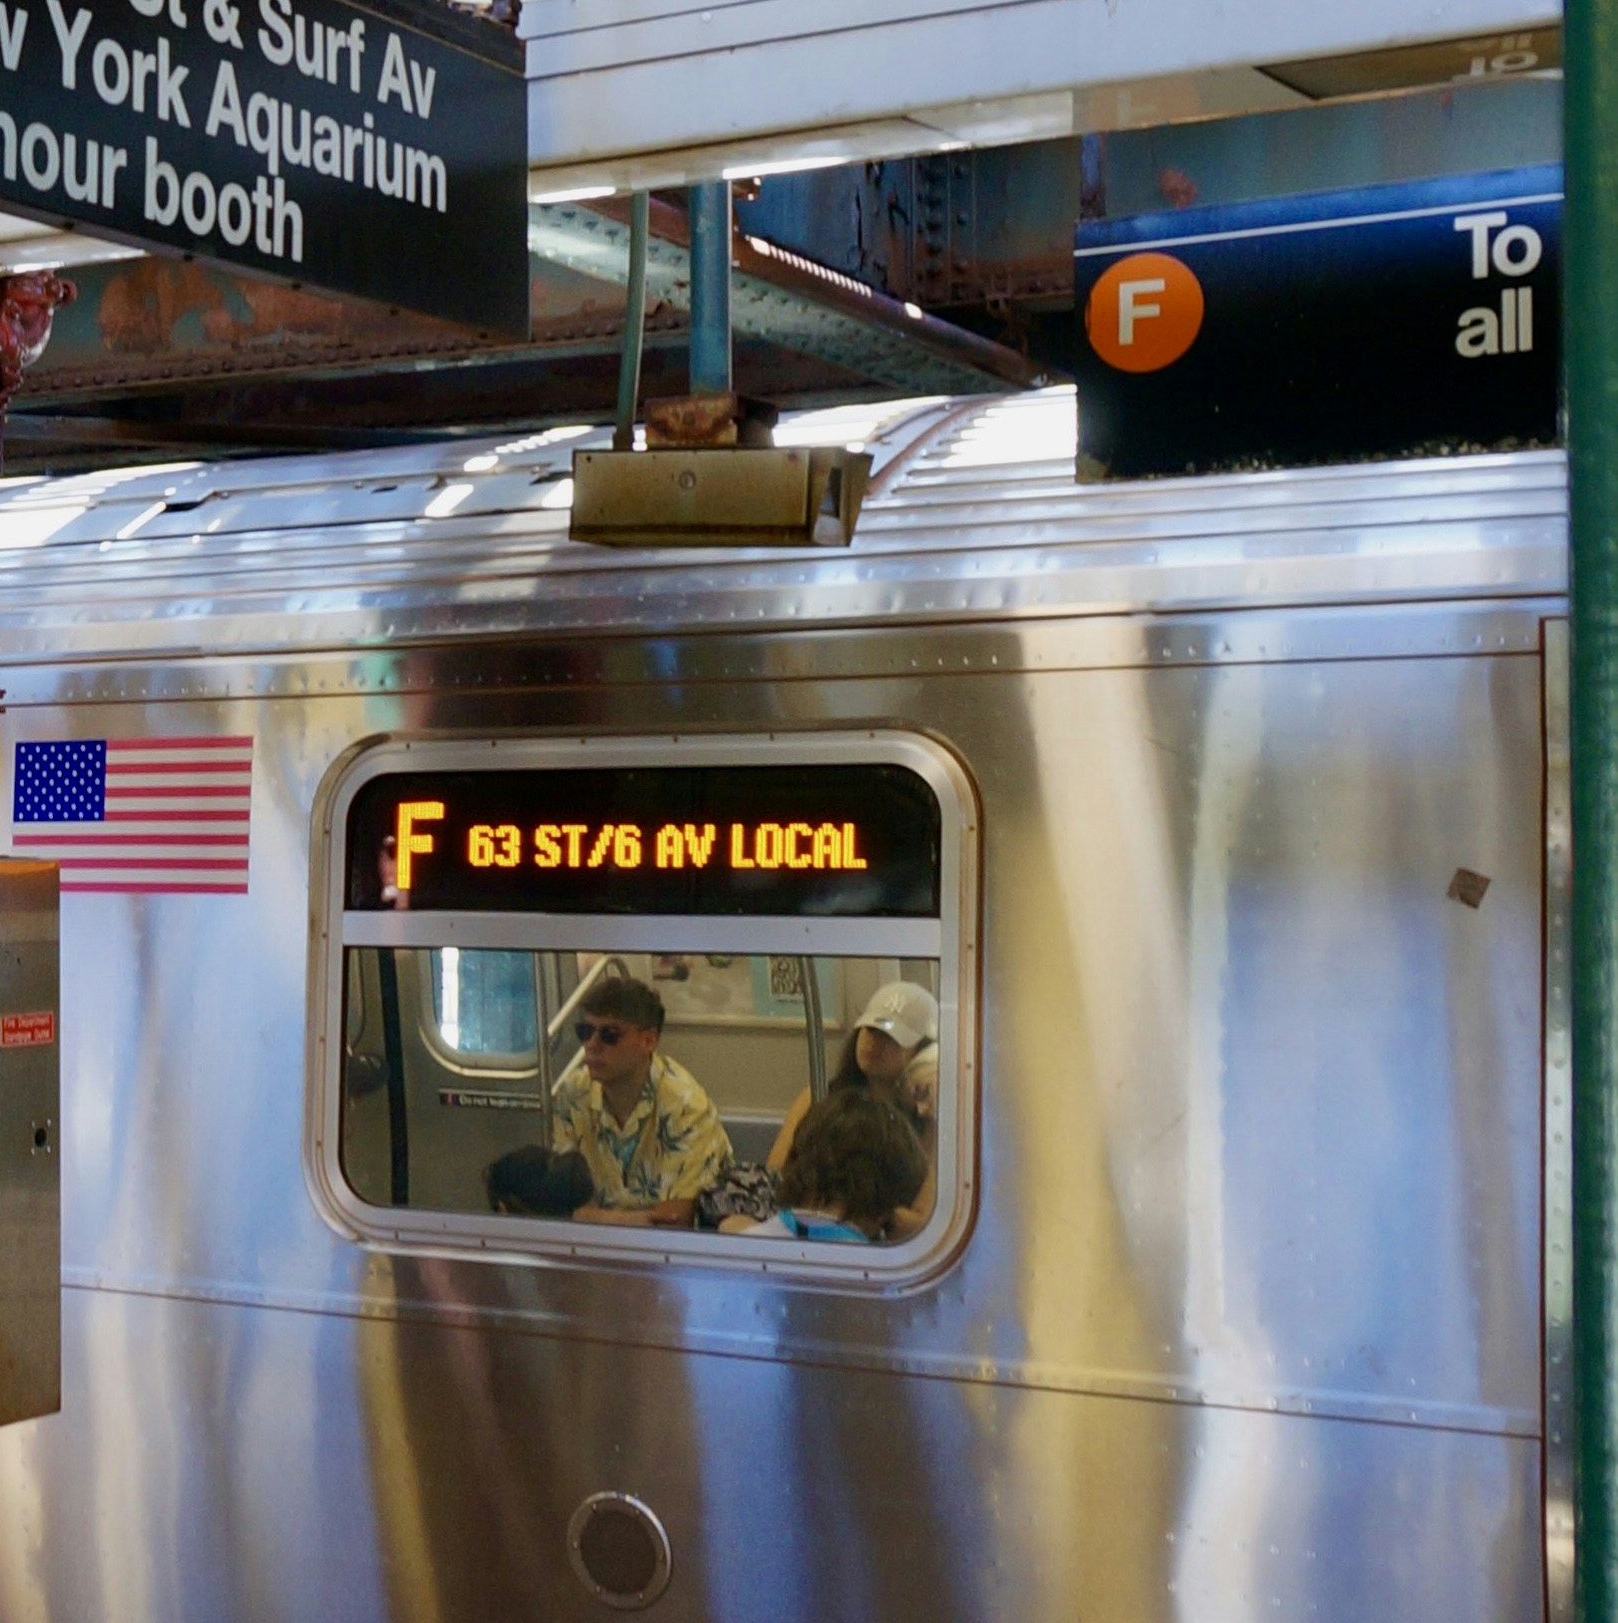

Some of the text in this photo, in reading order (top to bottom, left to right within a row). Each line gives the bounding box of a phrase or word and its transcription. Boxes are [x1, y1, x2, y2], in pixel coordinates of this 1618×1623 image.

[377, 33, 436, 120] Av
[205, 60, 448, 213] Aquarium
[143, 136, 303, 262] booth
[1453, 211, 1542, 279] To
[1118, 277, 1166, 346] F
[1454, 286, 1534, 359] all
[395, 800, 868, 890] F 63 ST/6 AV LOCAL
